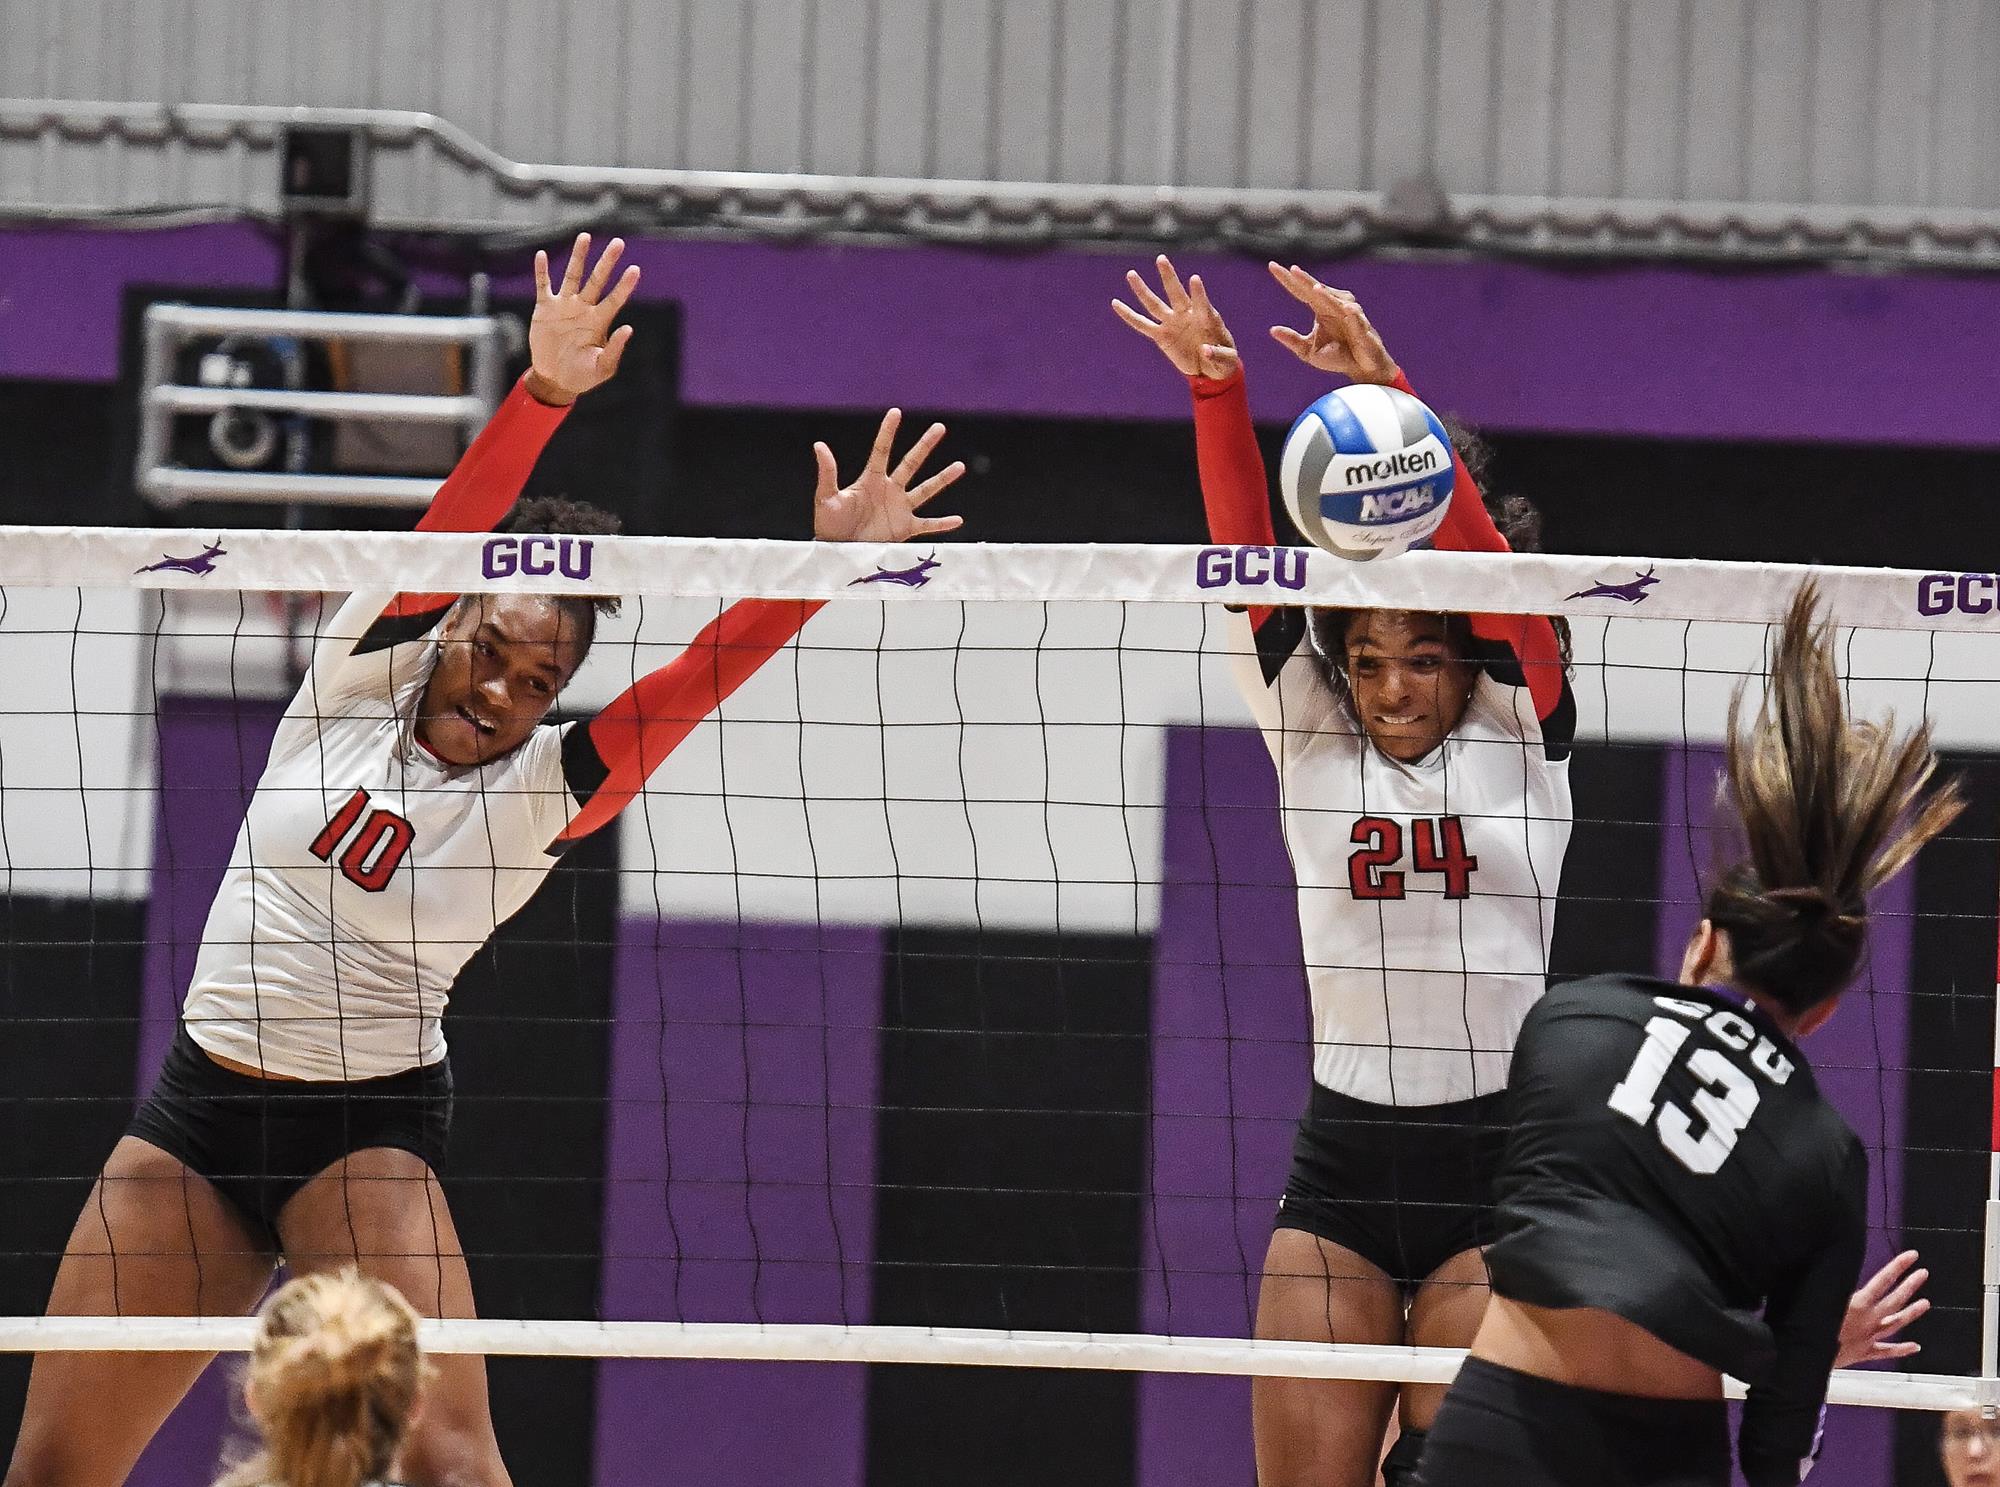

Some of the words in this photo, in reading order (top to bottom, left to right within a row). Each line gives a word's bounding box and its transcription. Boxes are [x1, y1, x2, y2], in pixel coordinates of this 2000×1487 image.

[1345, 449, 1437, 486] molten
[1360, 483, 1434, 521] NCAA
[481, 535, 594, 580] GCU
[1196, 545, 1309, 590] GCU
[1917, 573, 2000, 616] GC
[308, 784, 416, 893] 10
[1348, 815, 1478, 900] 24
[1607, 1015, 1761, 1174] 13
